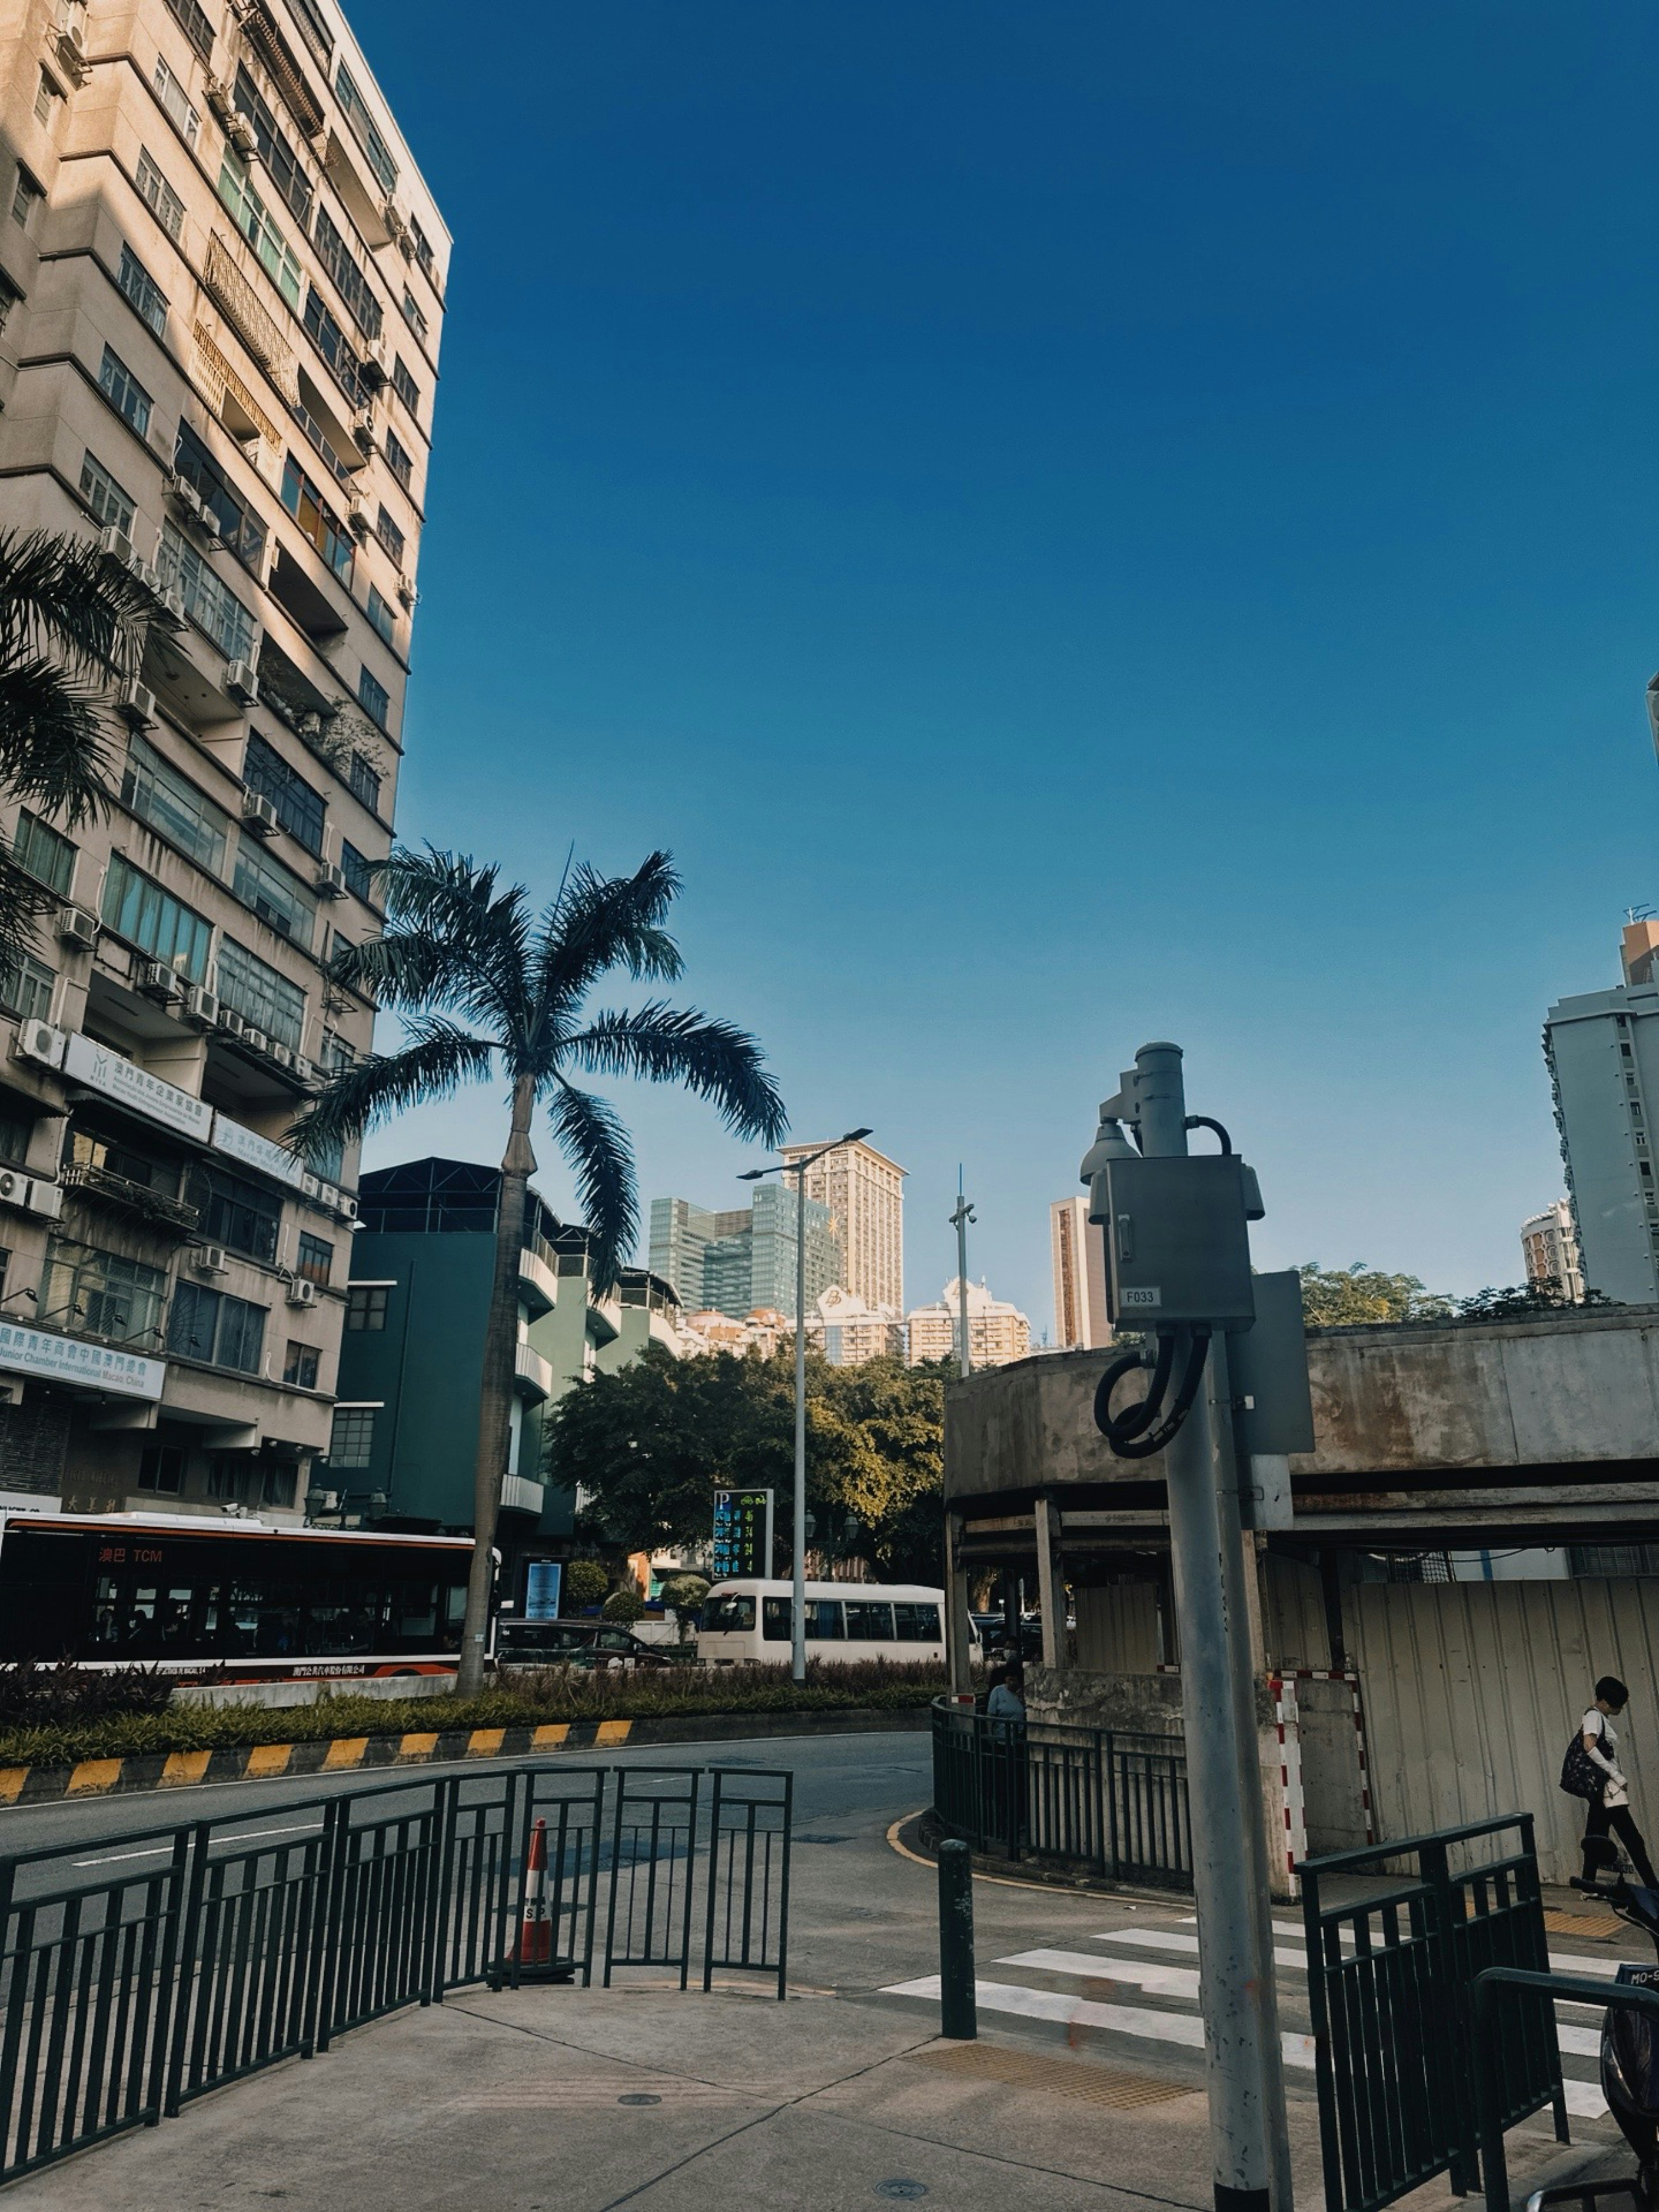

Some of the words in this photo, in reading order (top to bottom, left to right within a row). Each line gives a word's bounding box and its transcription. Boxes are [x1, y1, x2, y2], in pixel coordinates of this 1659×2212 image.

[1127, 1291, 1154, 1303] F033
[0, 1347, 23, 1361] Junior
[24, 1352, 58, 1368] Chamber
[58, 1359, 101, 1378] International
[126, 1375, 145, 1388] China
[719, 1493, 729, 1510] P
[98, 1547, 126, 1562] 澳巴
[133, 1549, 163, 1562] TCM
